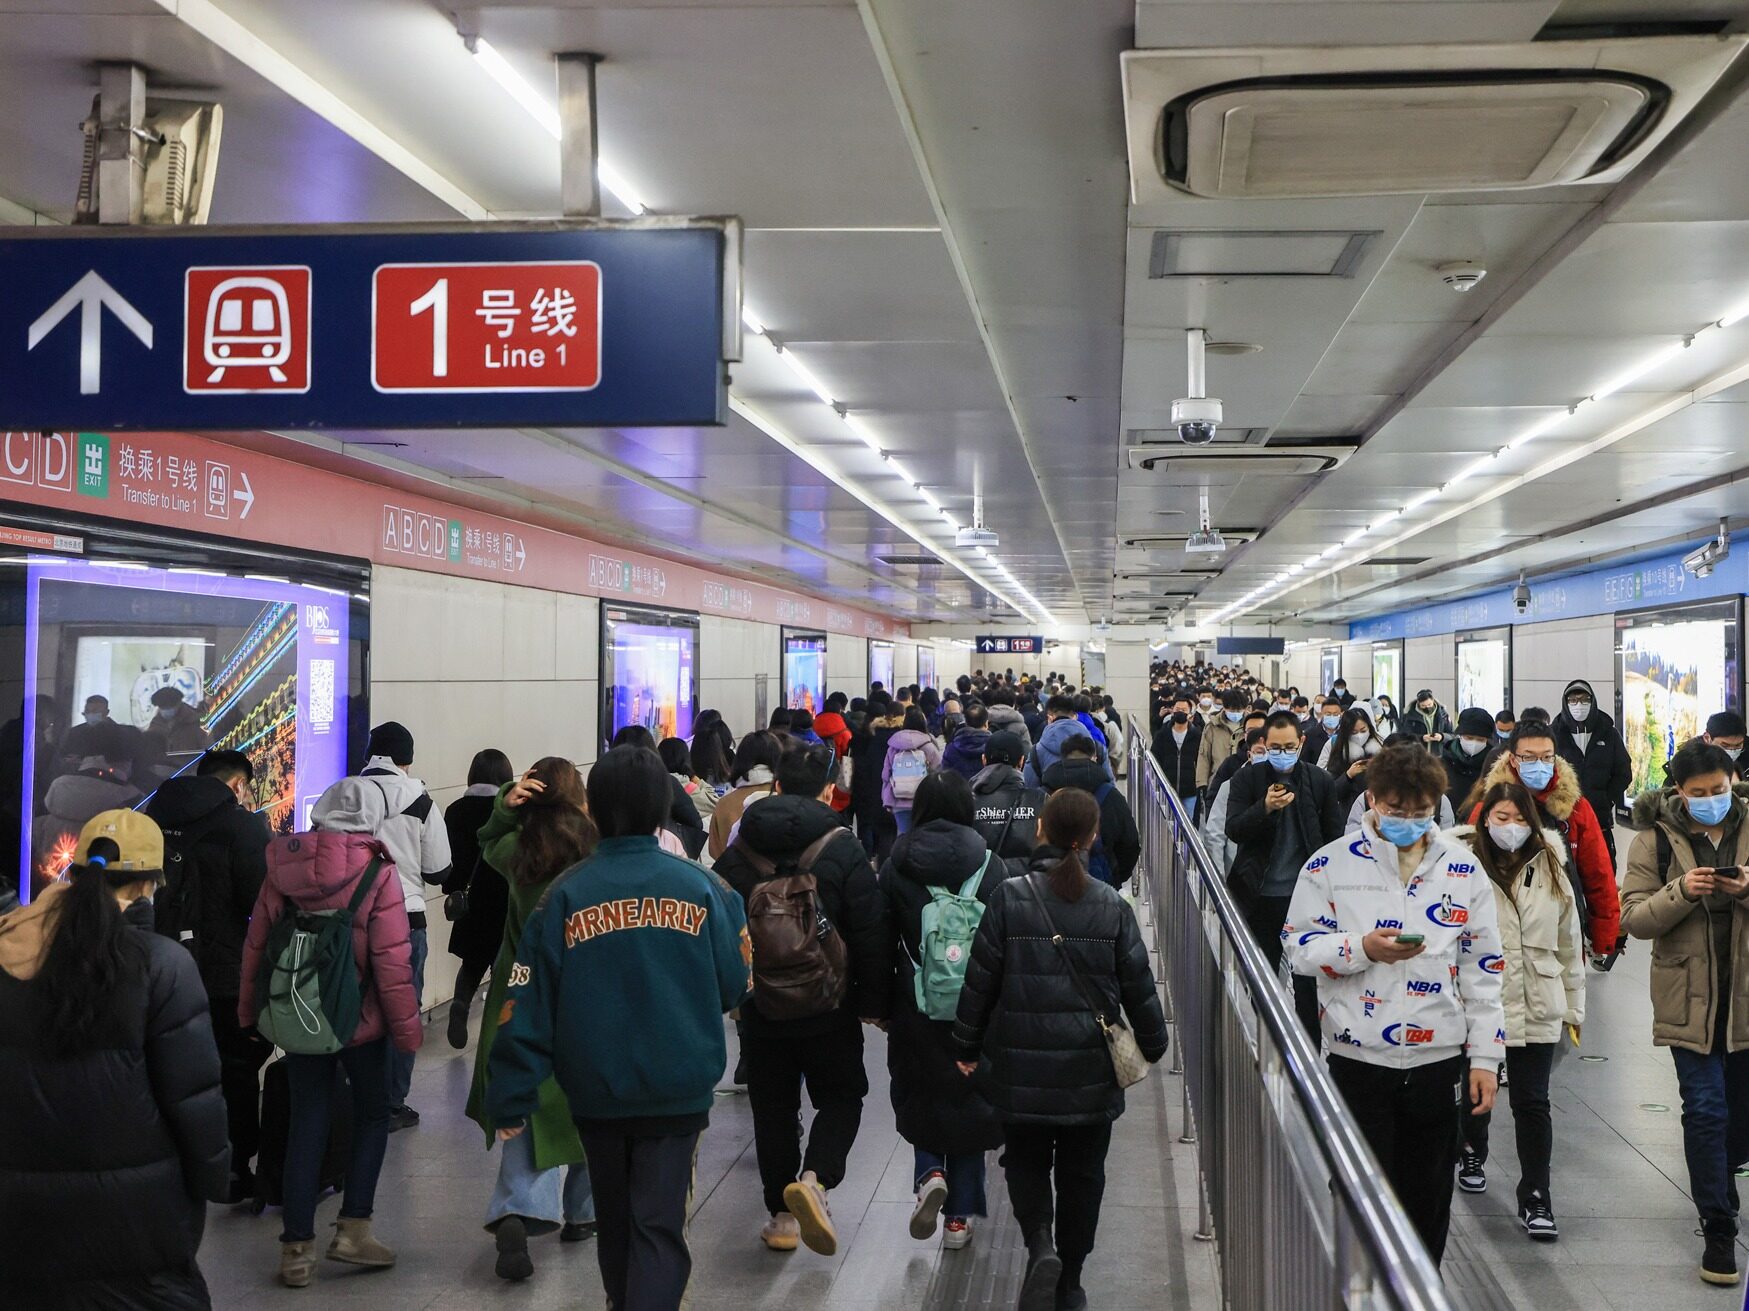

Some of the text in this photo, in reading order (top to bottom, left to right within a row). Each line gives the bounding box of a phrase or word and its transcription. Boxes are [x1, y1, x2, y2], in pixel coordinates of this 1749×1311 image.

[485, 343, 567, 368] Line 1
[85, 474, 102, 487] EXIT
[119, 443, 198, 491] 换乘1号线
[121, 483, 197, 513] Transfer to Line 1
[565, 897, 708, 948] MRNEARLY
[1407, 980, 1442, 994] NBA
